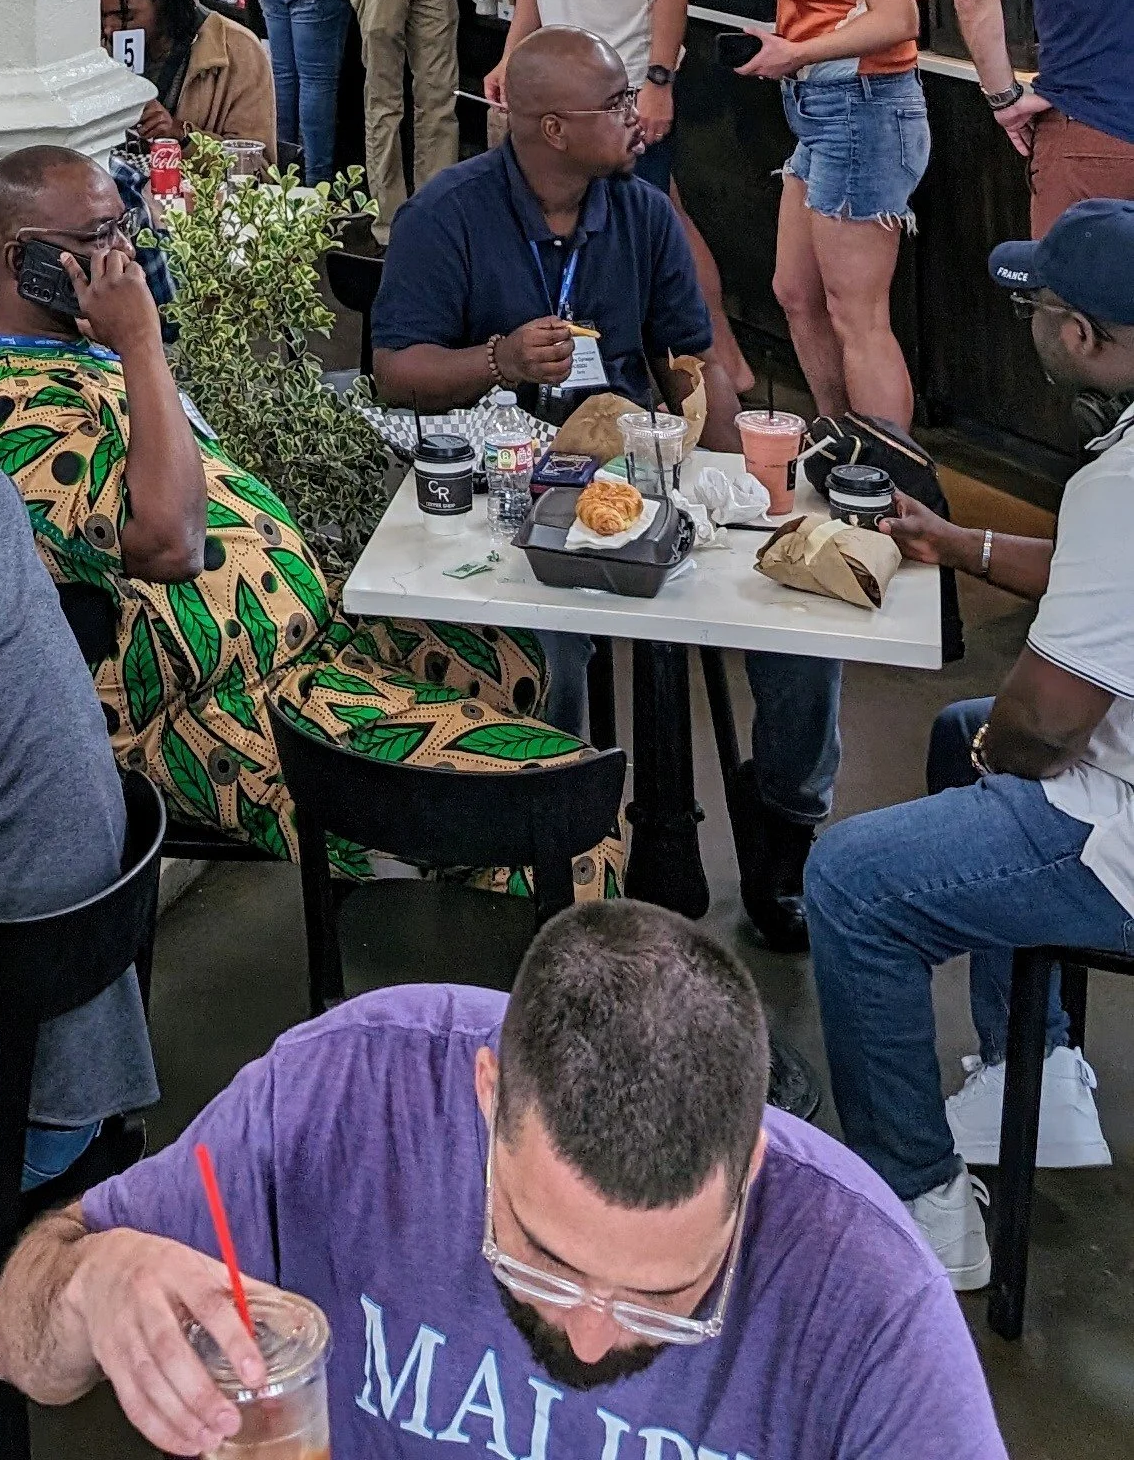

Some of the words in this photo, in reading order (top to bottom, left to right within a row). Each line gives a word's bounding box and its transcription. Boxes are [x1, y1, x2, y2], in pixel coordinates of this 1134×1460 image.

[124, 38, 135, 68] 5
[996, 266, 1029, 282] FRANCE
[428, 480, 450, 503] CR
[355, 1293, 755, 1460] MALI
